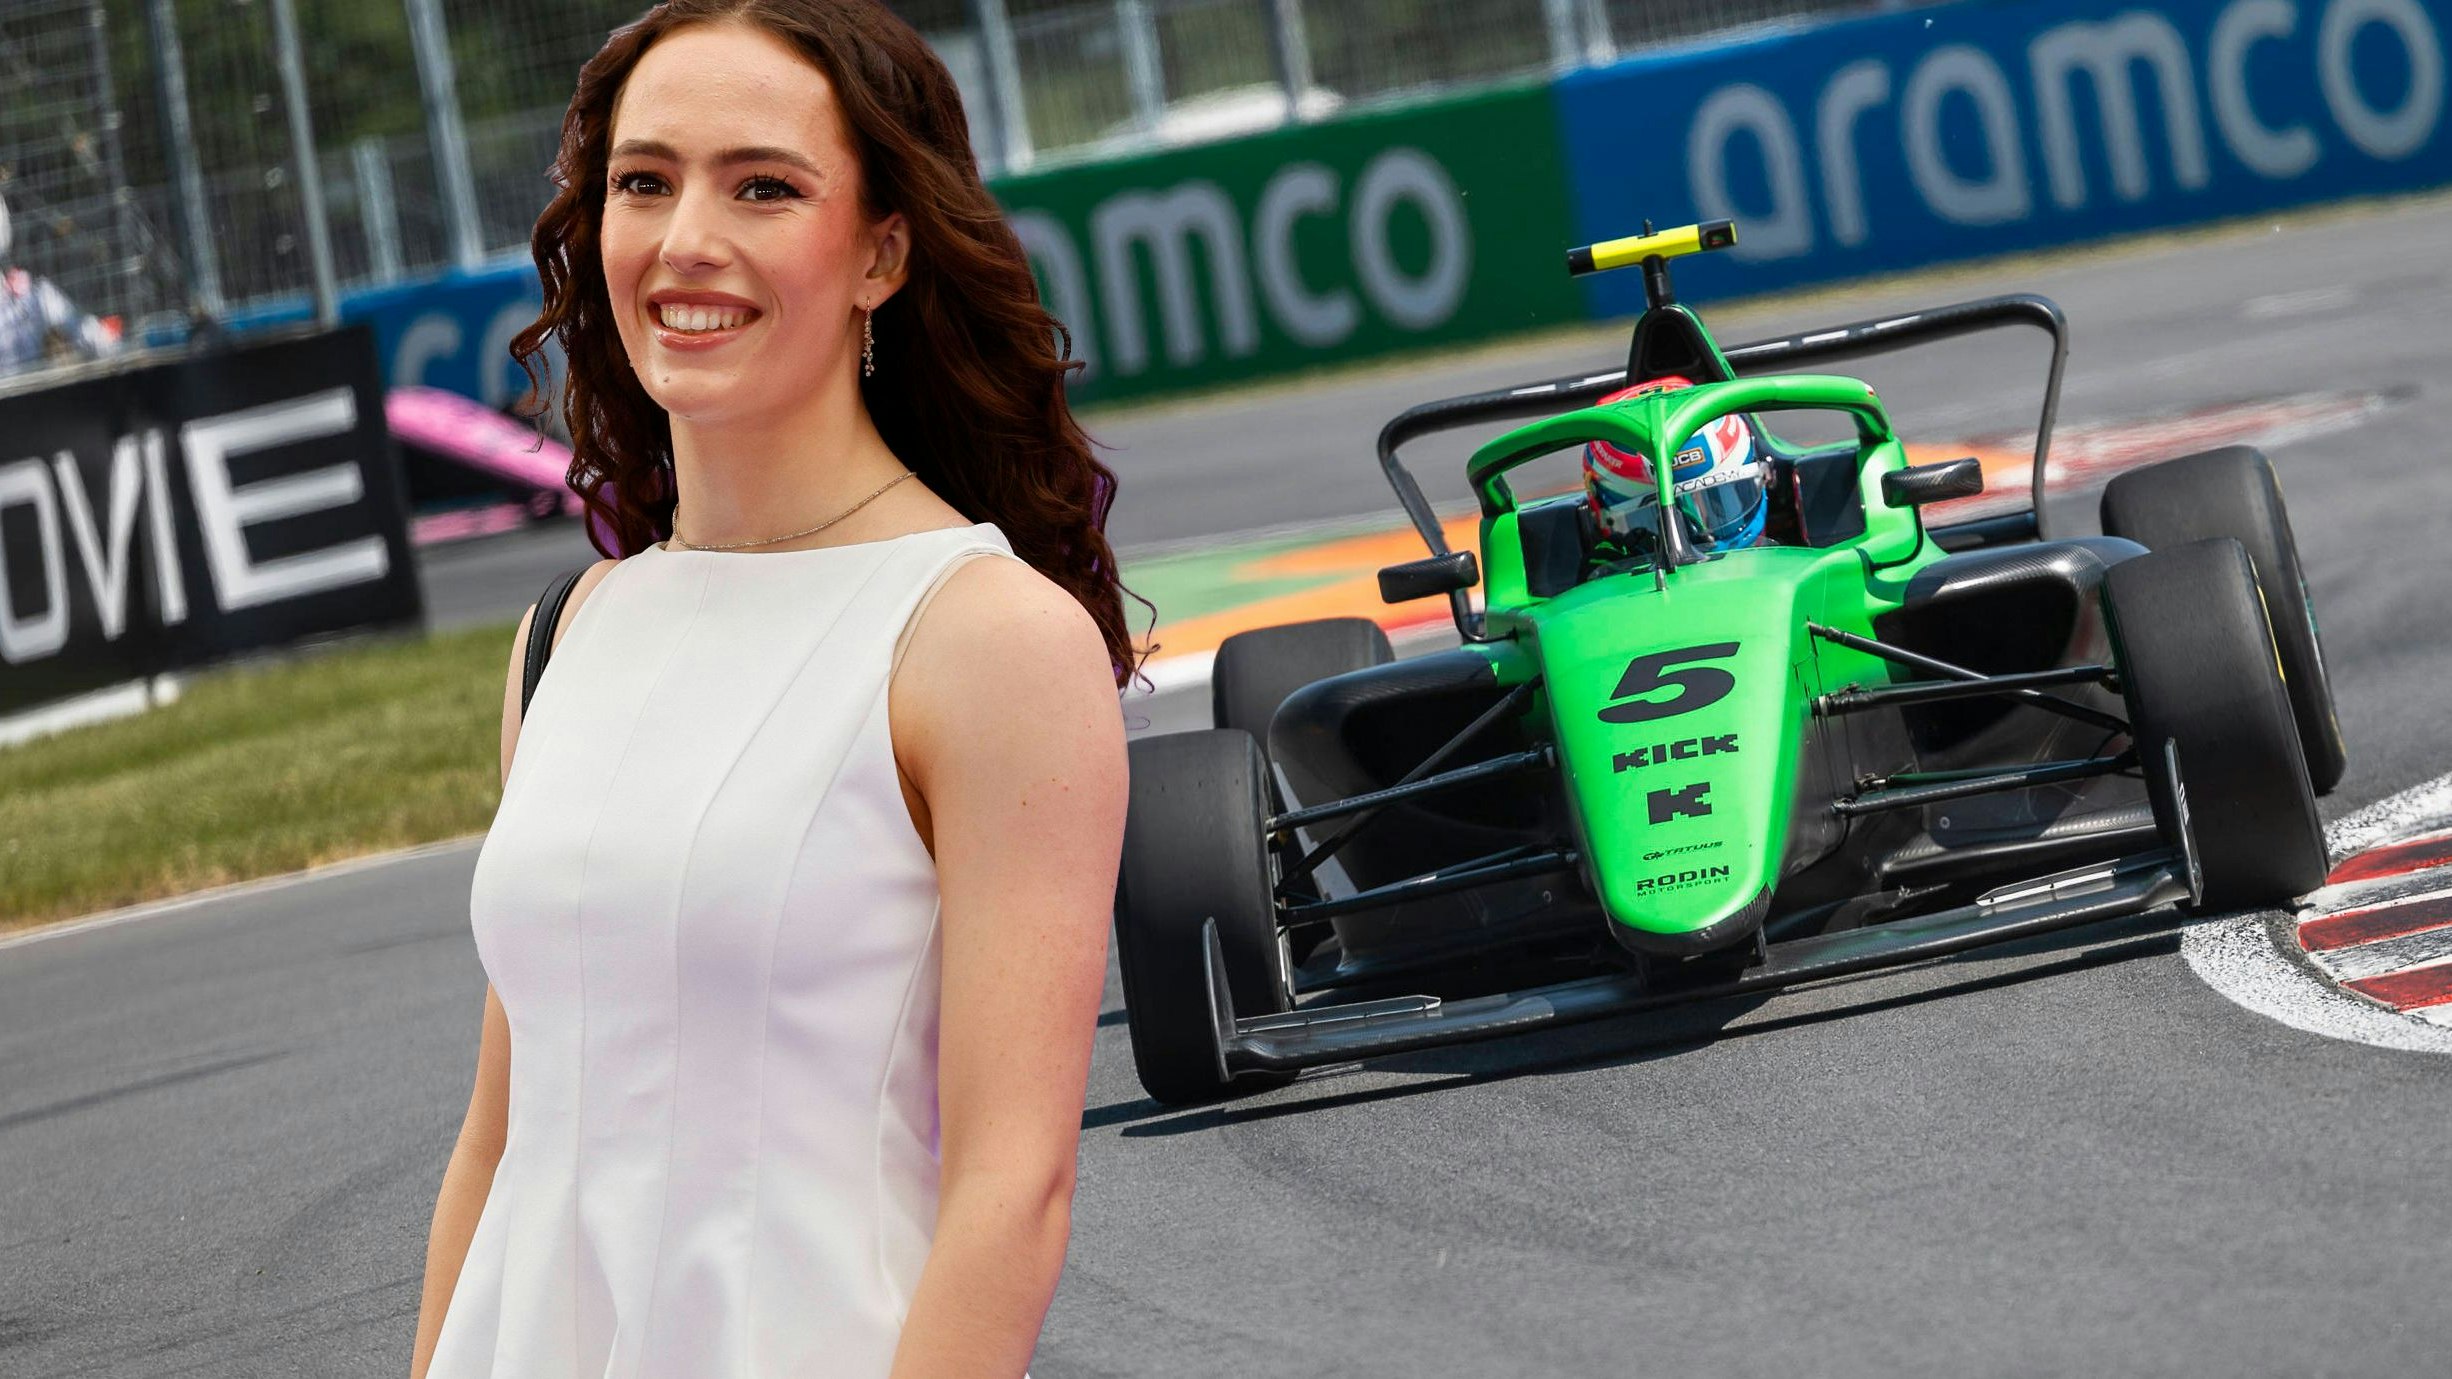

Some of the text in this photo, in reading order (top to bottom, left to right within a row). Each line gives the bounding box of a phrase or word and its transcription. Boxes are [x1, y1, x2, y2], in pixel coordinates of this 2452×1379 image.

[1686, 0, 2442, 262] aramco
[1597, 641, 1741, 724] 5
[1612, 733, 1739, 774] KICK
[1646, 781, 1713, 826] K
[1636, 865, 1730, 891] RODIN
[1637, 876, 1730, 897] MOTORSPORT
